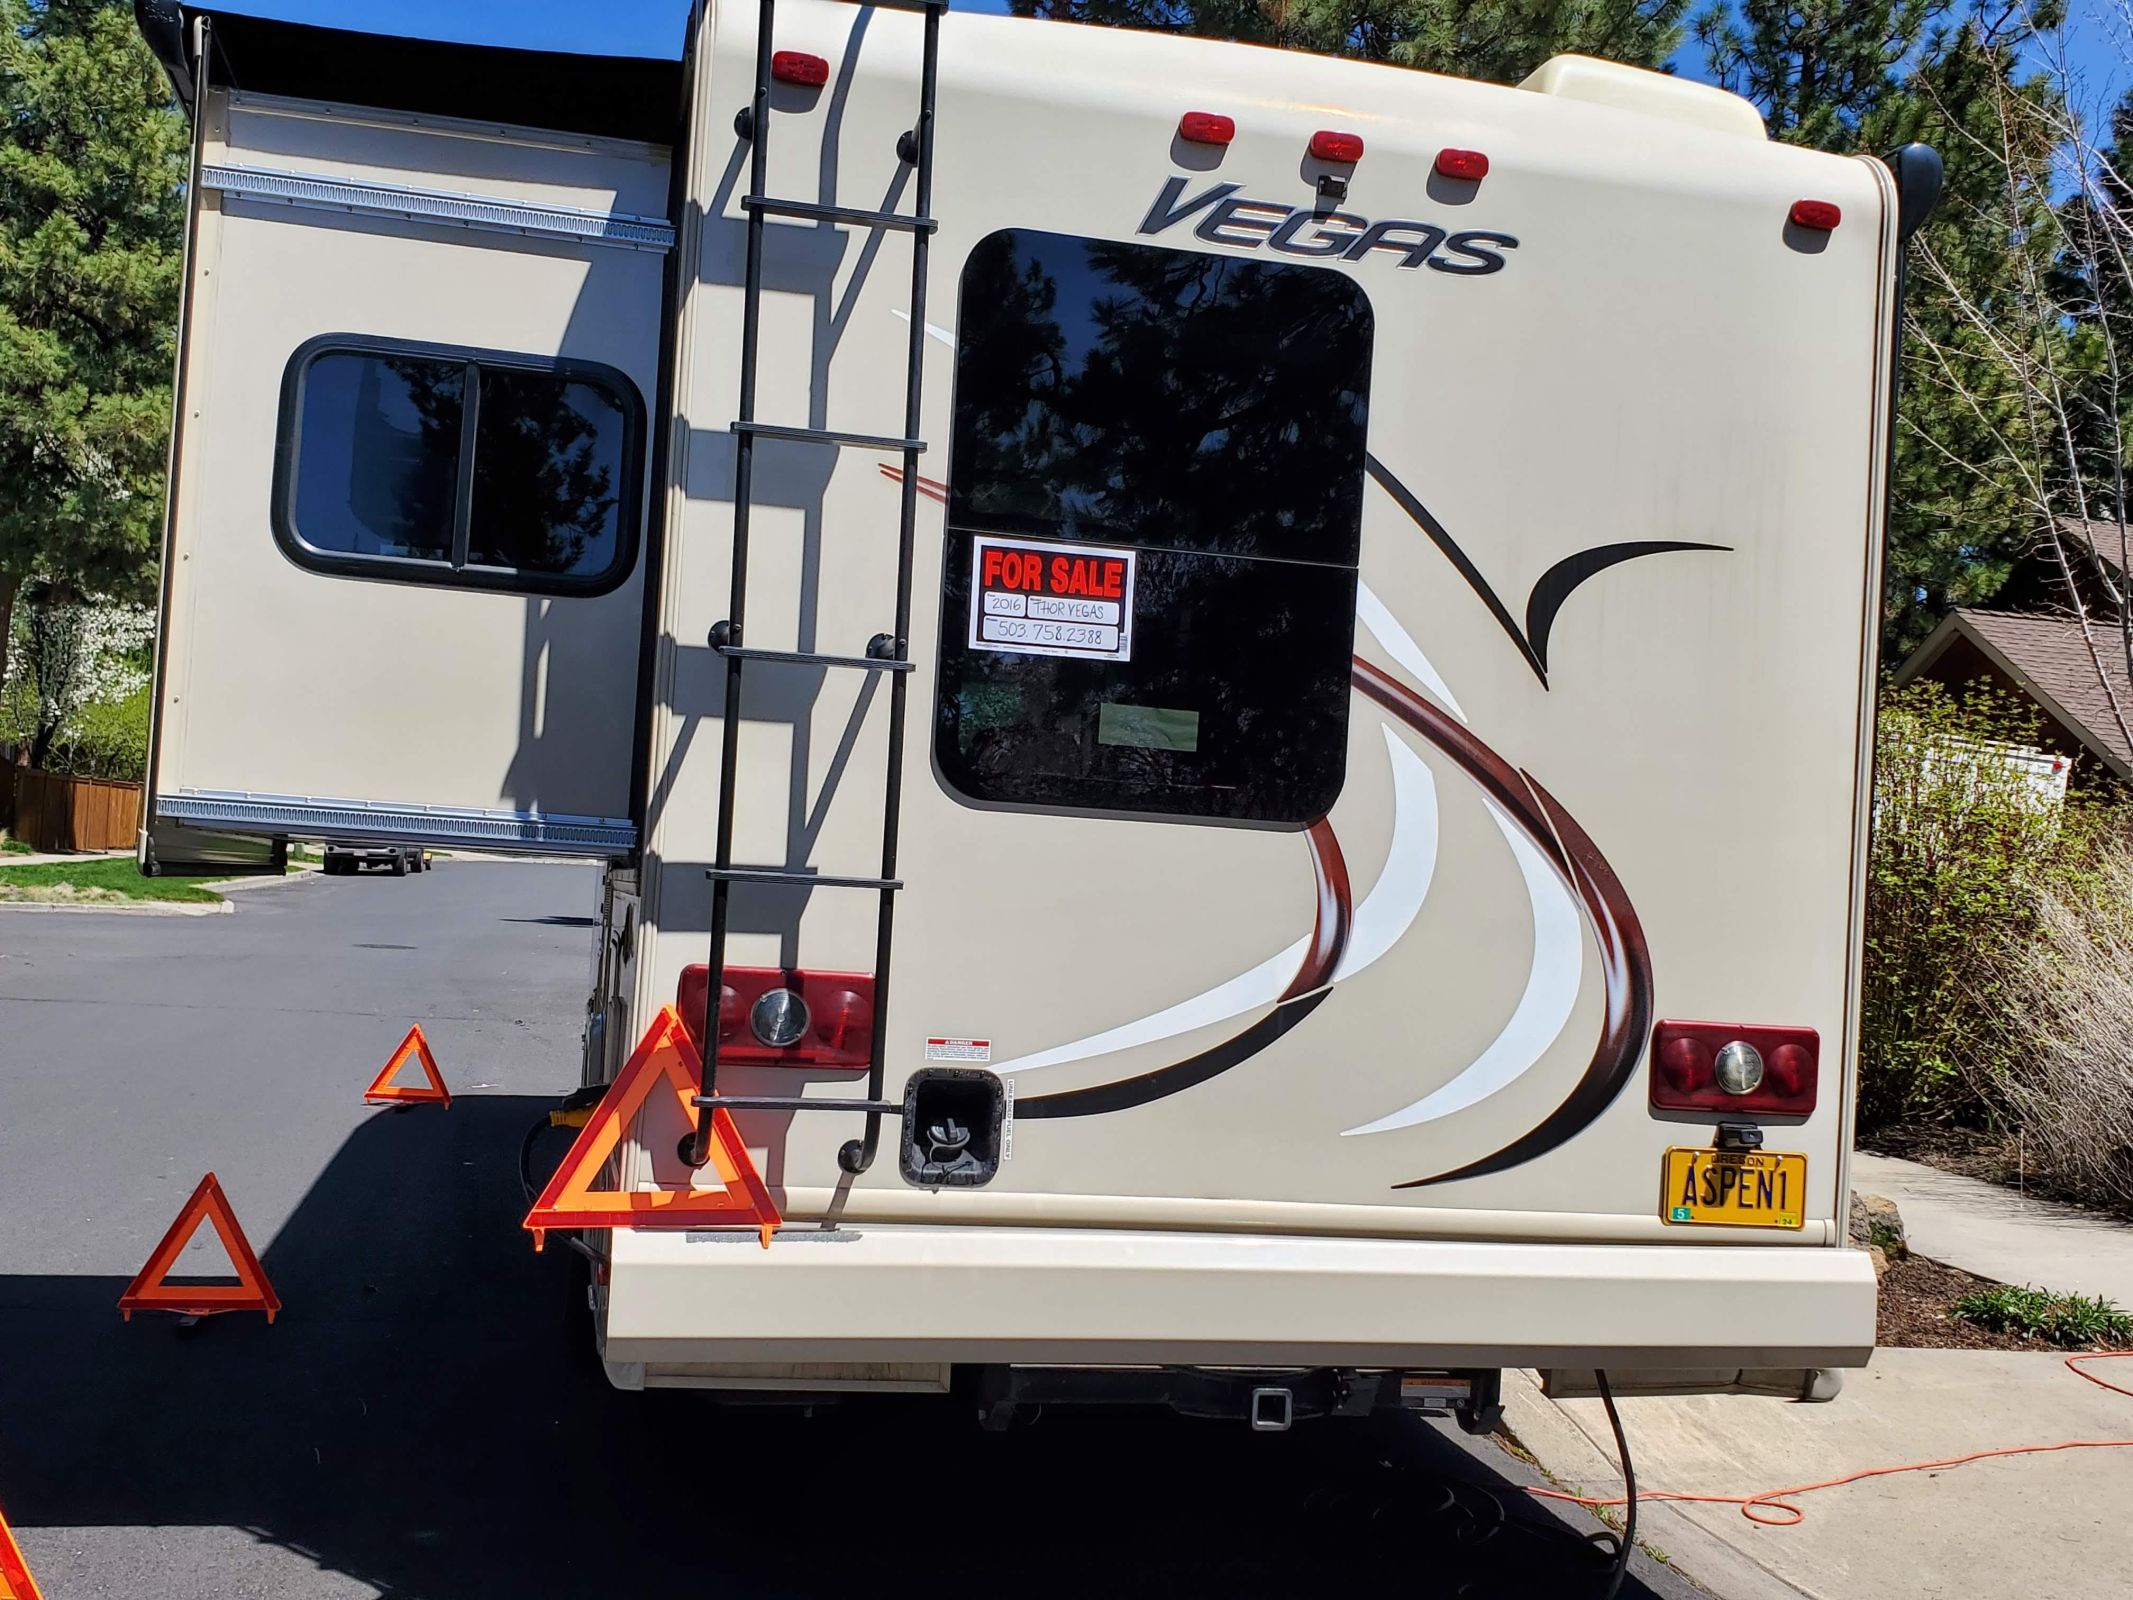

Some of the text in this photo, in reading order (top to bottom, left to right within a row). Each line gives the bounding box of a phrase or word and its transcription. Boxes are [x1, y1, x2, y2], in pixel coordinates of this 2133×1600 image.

[1135, 174, 1520, 276] VEGAS
[983, 551, 1123, 598] FOR SALE
[992, 597, 1021, 611] 2016
[1033, 600, 1104, 620] THOR VEGAS
[1006, 1080, 1014, 1119] UNLEADED
[1711, 1154, 1765, 1167] OREGON
[1681, 1165, 1788, 1210] ASPEN1
[1676, 1208, 1685, 1219] 5
